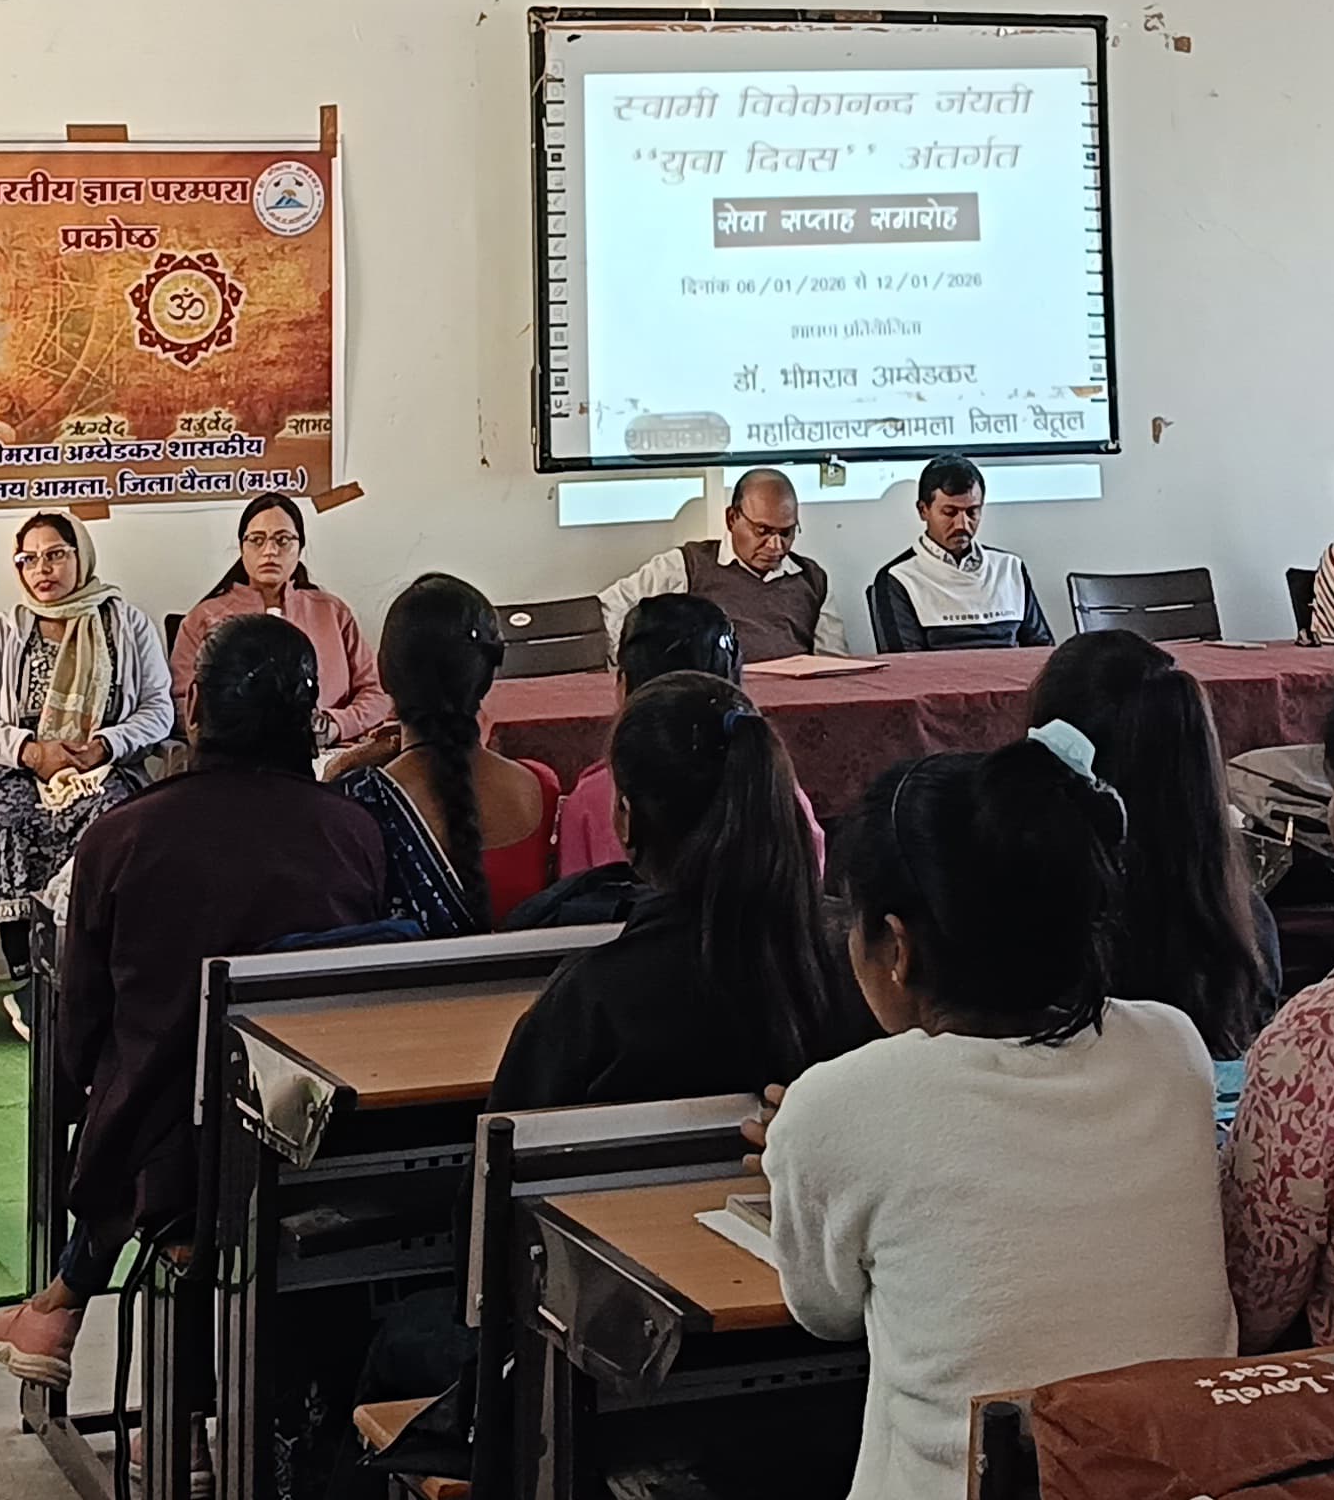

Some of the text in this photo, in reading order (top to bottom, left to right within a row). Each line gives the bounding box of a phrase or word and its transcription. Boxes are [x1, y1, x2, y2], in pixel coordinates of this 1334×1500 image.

[613, 86, 720, 121] स्वामी
[738, 84, 918, 118] विवेकानन्द
[82, 179, 144, 203] ज्ञान
[150, 178, 249, 202] परम्परा
[716, 197, 958, 236] सेवा सप्ताह समारोह
[61, 218, 159, 251] प्रकोष्ठ
[734, 357, 978, 394] डॉ. भीमराव अम्बेडकर
[747, 414, 869, 447] महाविद्यालय
[968, 406, 1018, 434] जिला
[1027, 404, 1085, 439] बैतूल
[169, 433, 264, 460] शासकीय
[119, 470, 174, 495] जिला
[1219, 1363, 1289, 1383] Cat
[1210, 1376, 1329, 1405] Lovely
